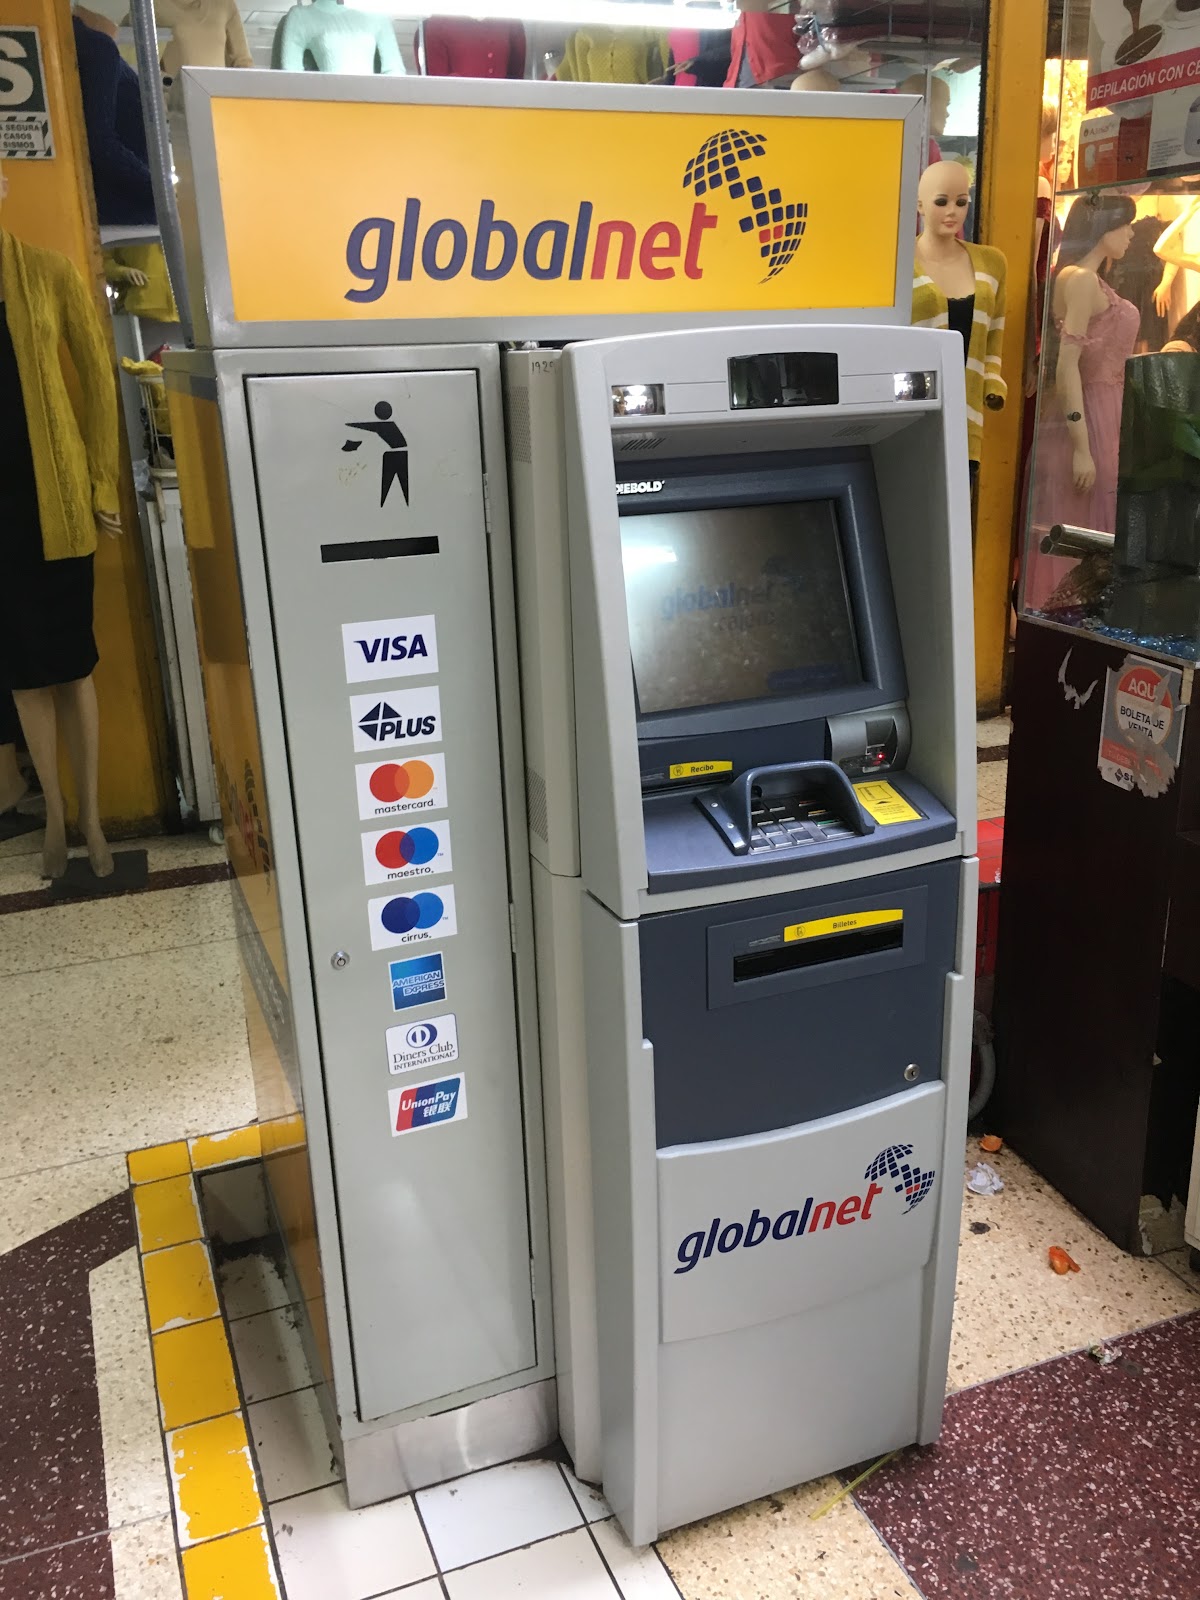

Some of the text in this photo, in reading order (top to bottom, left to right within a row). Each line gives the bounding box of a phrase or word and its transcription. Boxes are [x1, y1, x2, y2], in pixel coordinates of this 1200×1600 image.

[0, 36, 34, 106] S
[1090, 70, 1156, 102] DEPILACIÓN
[1158, 64, 1185, 84] CON
[3, 132, 32, 140] CASOS
[5, 124, 40, 132] SEGURA
[3, 141, 35, 149] SISMOS
[344, 197, 718, 304] globalnet
[353, 633, 428, 664] VISA
[1128, 677, 1160, 700] AQU
[1120, 706, 1150, 725] BOLETA
[379, 715, 436, 742] PLUS
[690, 764, 714, 773] Recibo
[832, 919, 857, 929] Billetes
[393, 970, 441, 987] AMERICAN
[404, 980, 445, 995] EXPRESS
[393, 1040, 454, 1063] Diners Club
[401, 1091, 457, 1111] UnionPay
[673, 1182, 883, 1274] globalnet
